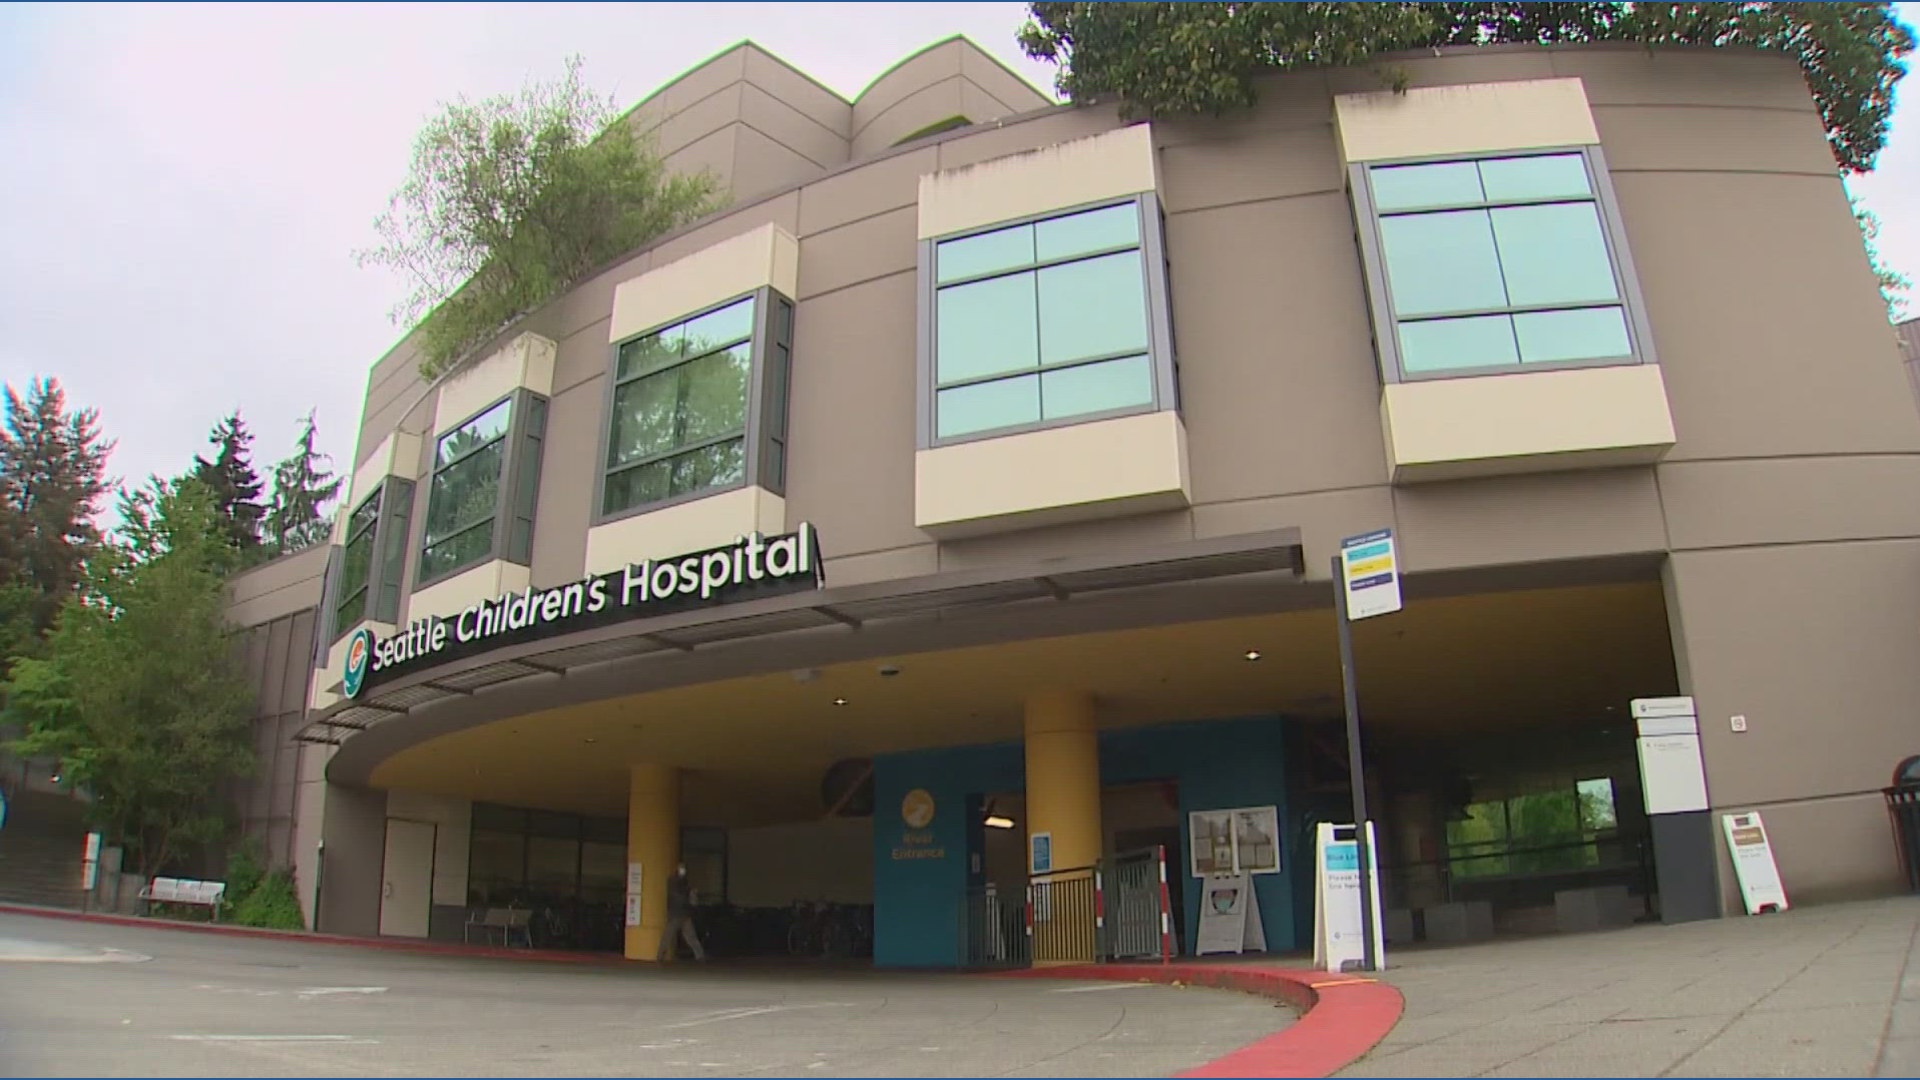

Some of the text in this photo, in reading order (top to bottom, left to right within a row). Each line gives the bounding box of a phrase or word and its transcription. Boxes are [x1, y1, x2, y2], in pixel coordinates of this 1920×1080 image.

[372, 520, 810, 672] Seattle Children's Hospital
[891, 847, 945, 860] Entrance
